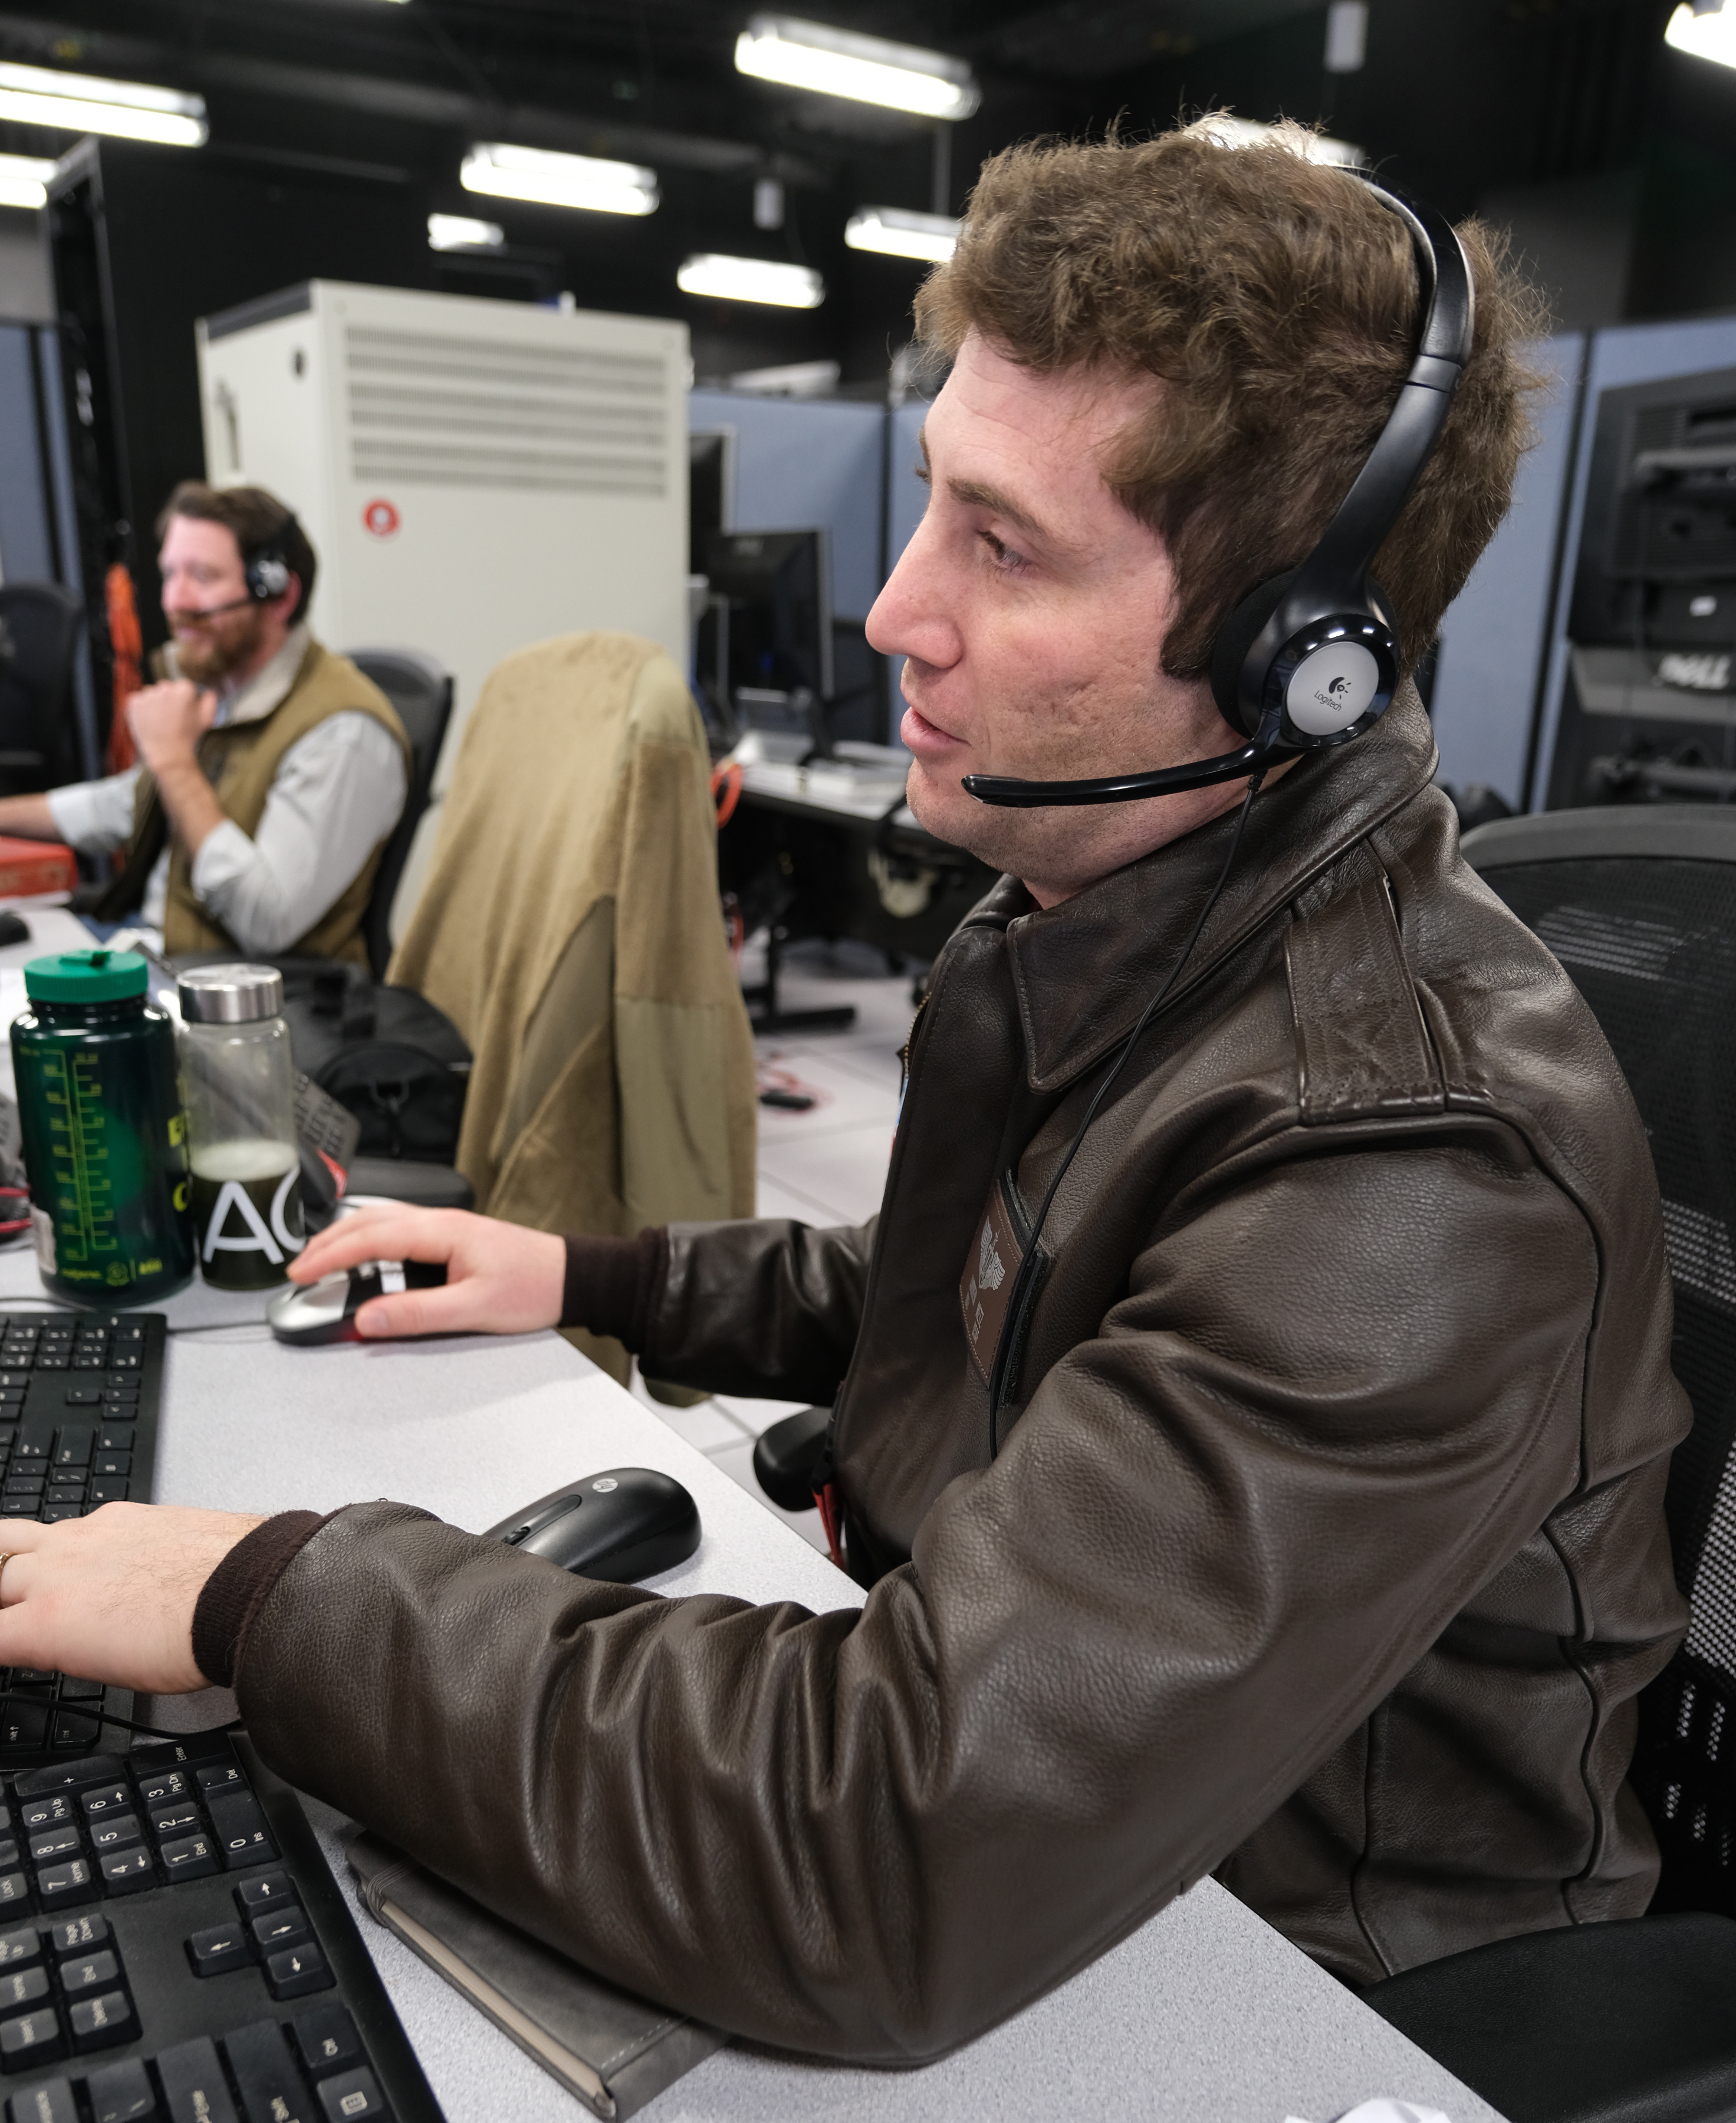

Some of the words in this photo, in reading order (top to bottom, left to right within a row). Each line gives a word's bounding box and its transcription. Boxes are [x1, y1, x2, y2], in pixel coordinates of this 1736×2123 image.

[1314, 690, 1342, 712] Logitech
[175, 1747, 187, 1762] Enter
[169, 1774, 179, 1784] Dn
[226, 1769, 238, 1780] Del
[172, 1783, 182, 1792] Pg
[148, 1789, 164, 1797] 3
[51, 1799, 63, 1810] Up
[90, 1800, 106, 1809] 6
[31, 1813, 47, 1822] 9
[54, 1807, 65, 1818] Pg
[159, 1819, 176, 1829] 2
[100, 1832, 117, 1842] 5
[230, 1839, 246, 1848] 0
[37, 1846, 54, 1855] 8
[193, 1842, 207, 1856] End
[172, 1853, 189, 1862] 1
[71, 1861, 85, 1884] Home
[111, 1865, 128, 1874] 4
[48, 1881, 67, 1891] 7
